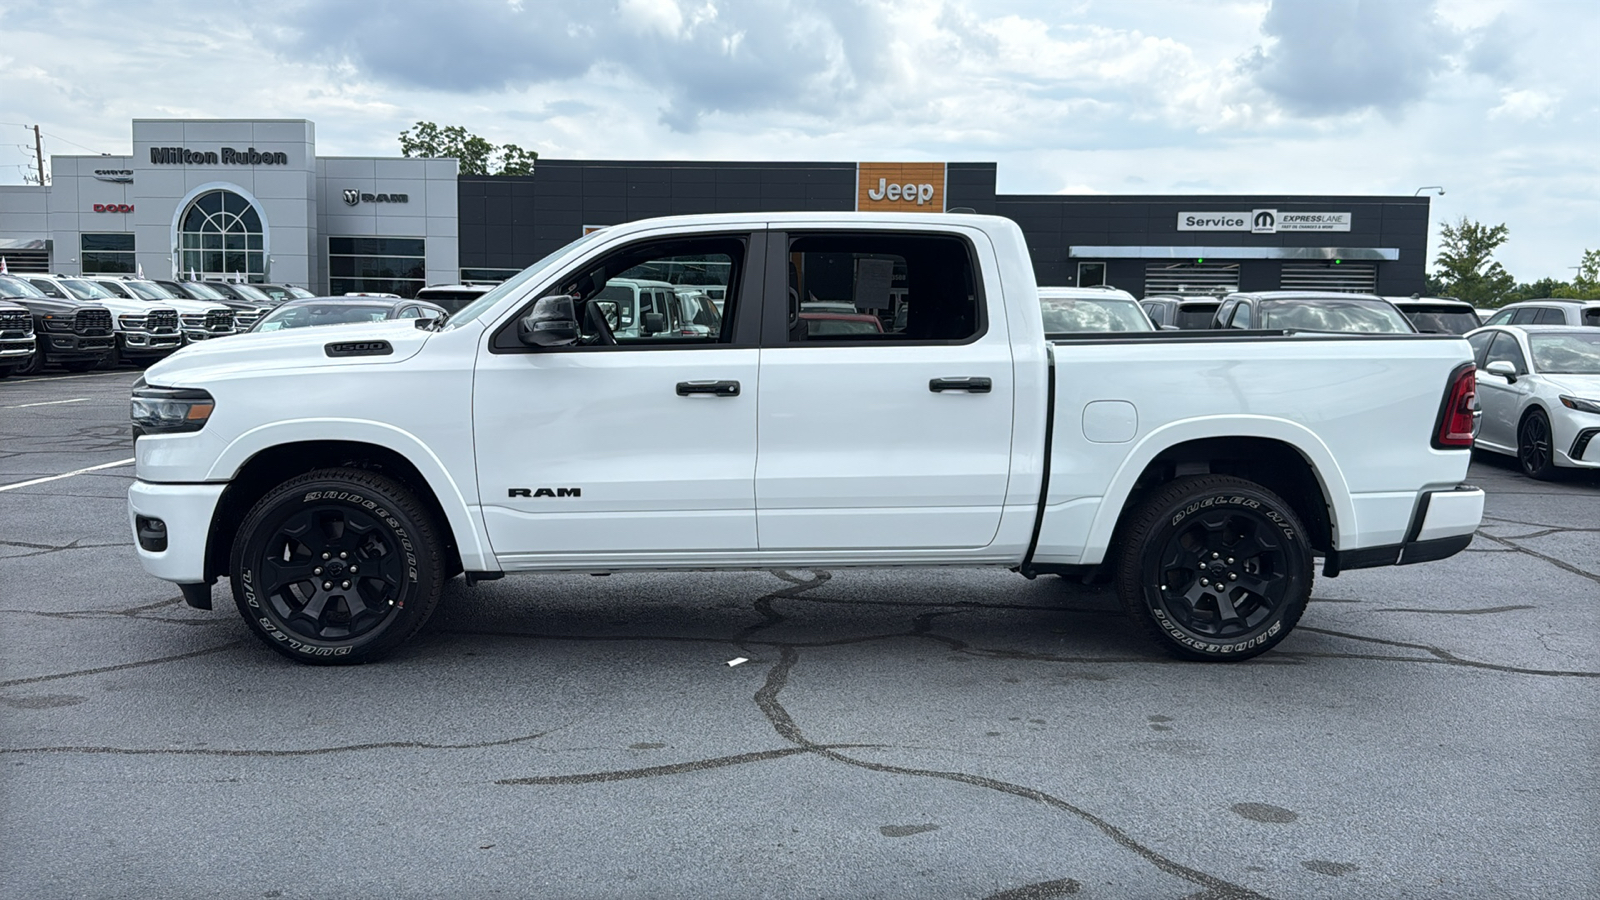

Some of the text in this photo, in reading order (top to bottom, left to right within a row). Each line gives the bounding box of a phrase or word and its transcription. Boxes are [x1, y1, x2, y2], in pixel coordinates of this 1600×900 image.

[150, 147, 288, 165] Milton Ruben
[361, 193, 408, 203] RAM
[868, 178, 934, 205] Jeep
[1186, 216, 1244, 227] Service
[333, 343, 383, 351] 1500
[508, 488, 581, 498] RAM
[1172, 496, 1261, 526] DUELER
[303, 491, 419, 584] BRIDGESTONE
[258, 617, 353, 657] DUELER
[1153, 608, 1281, 653] BRIDGESTONE
